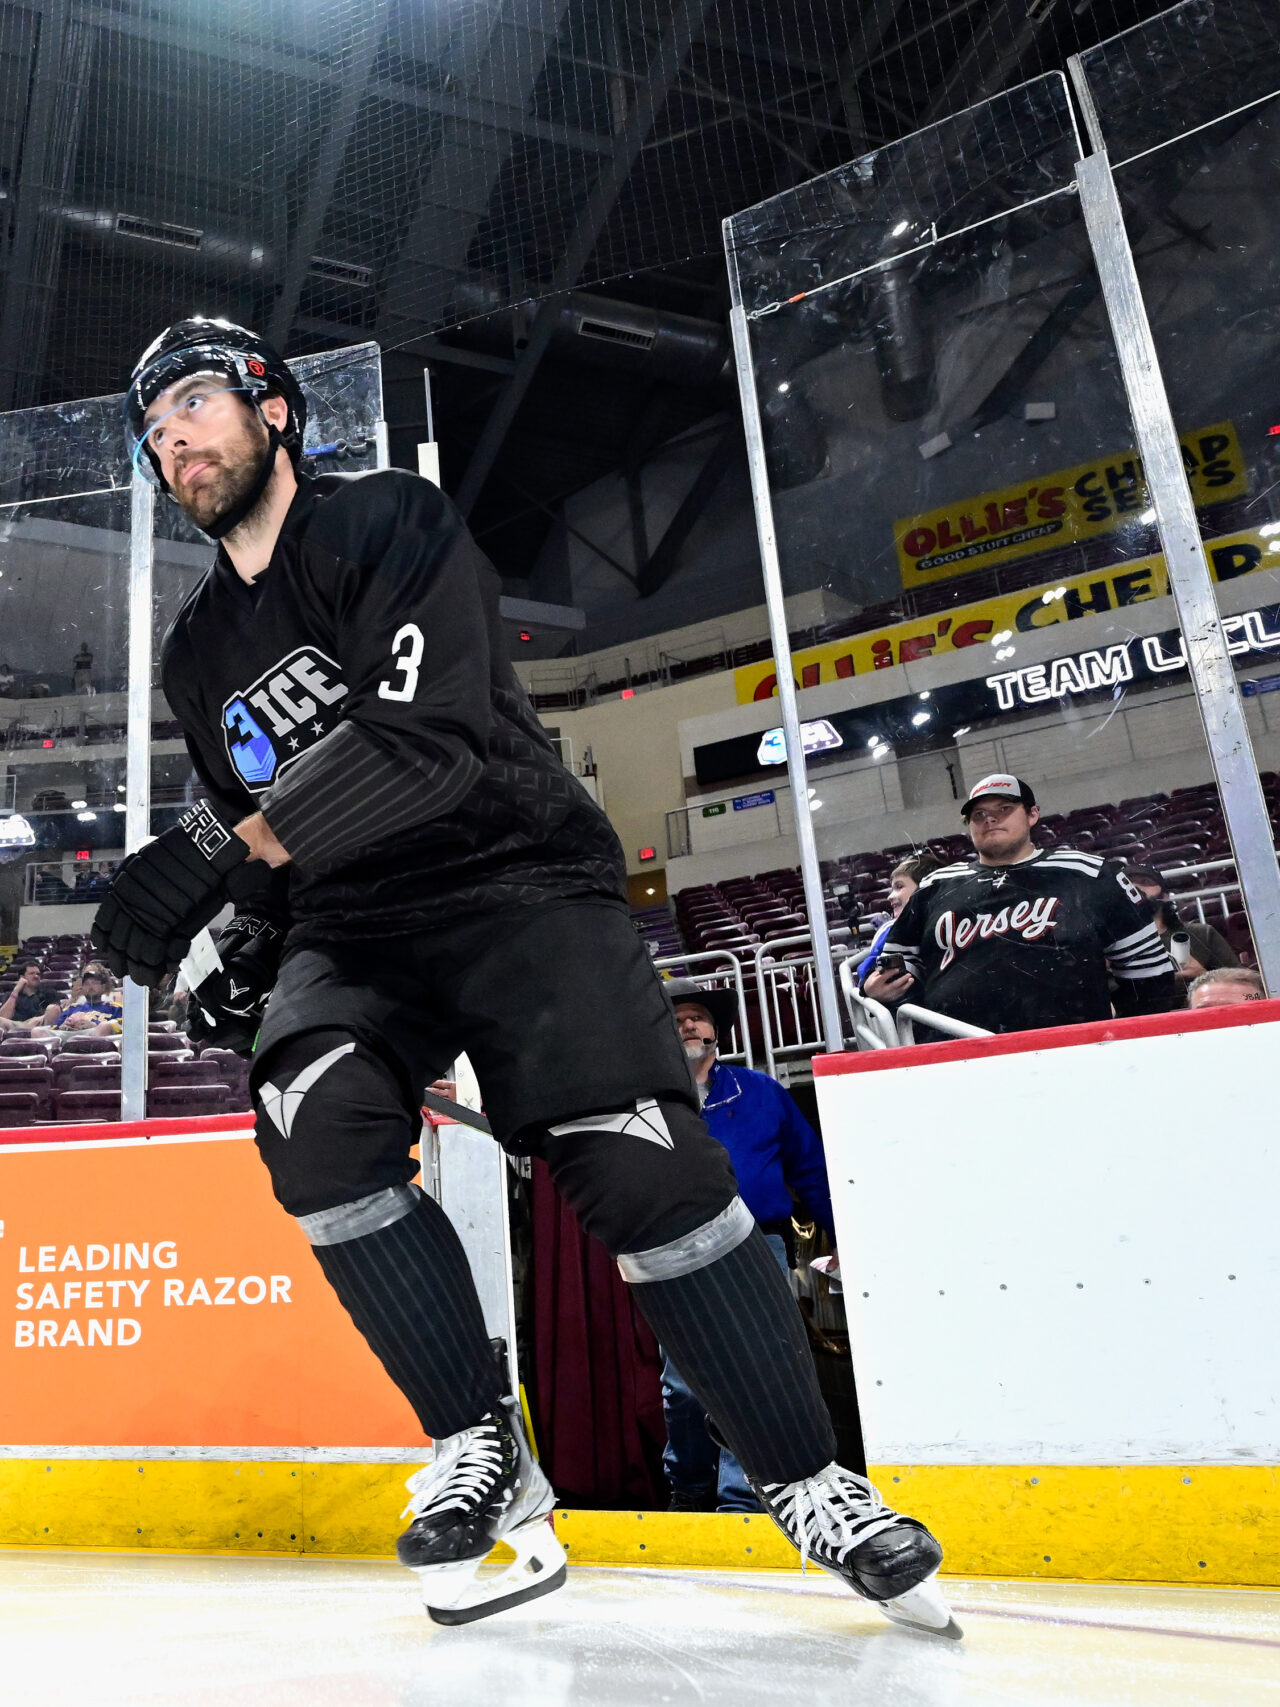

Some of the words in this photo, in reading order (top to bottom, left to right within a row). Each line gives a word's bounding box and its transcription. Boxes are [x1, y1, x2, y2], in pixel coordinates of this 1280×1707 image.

[1075, 434, 1230, 498] CHAP
[1083, 460, 1236, 522] SES
[903, 487, 1067, 558] OLLIE'S
[920, 548, 965, 569] GOOD
[968, 537, 1010, 556] STUFF
[1013, 524, 1056, 543] CHEAP
[1015, 543, 1263, 633] CHEP
[377, 622, 425, 703] 3
[986, 645, 1134, 710] TEAM
[934, 897, 1058, 971] Jersey
[19, 1240, 178, 1273] LEADING
[15, 1279, 151, 1311] SAFETY
[163, 1275, 293, 1307] RAZOR
[14, 1318, 142, 1348] BRAND
